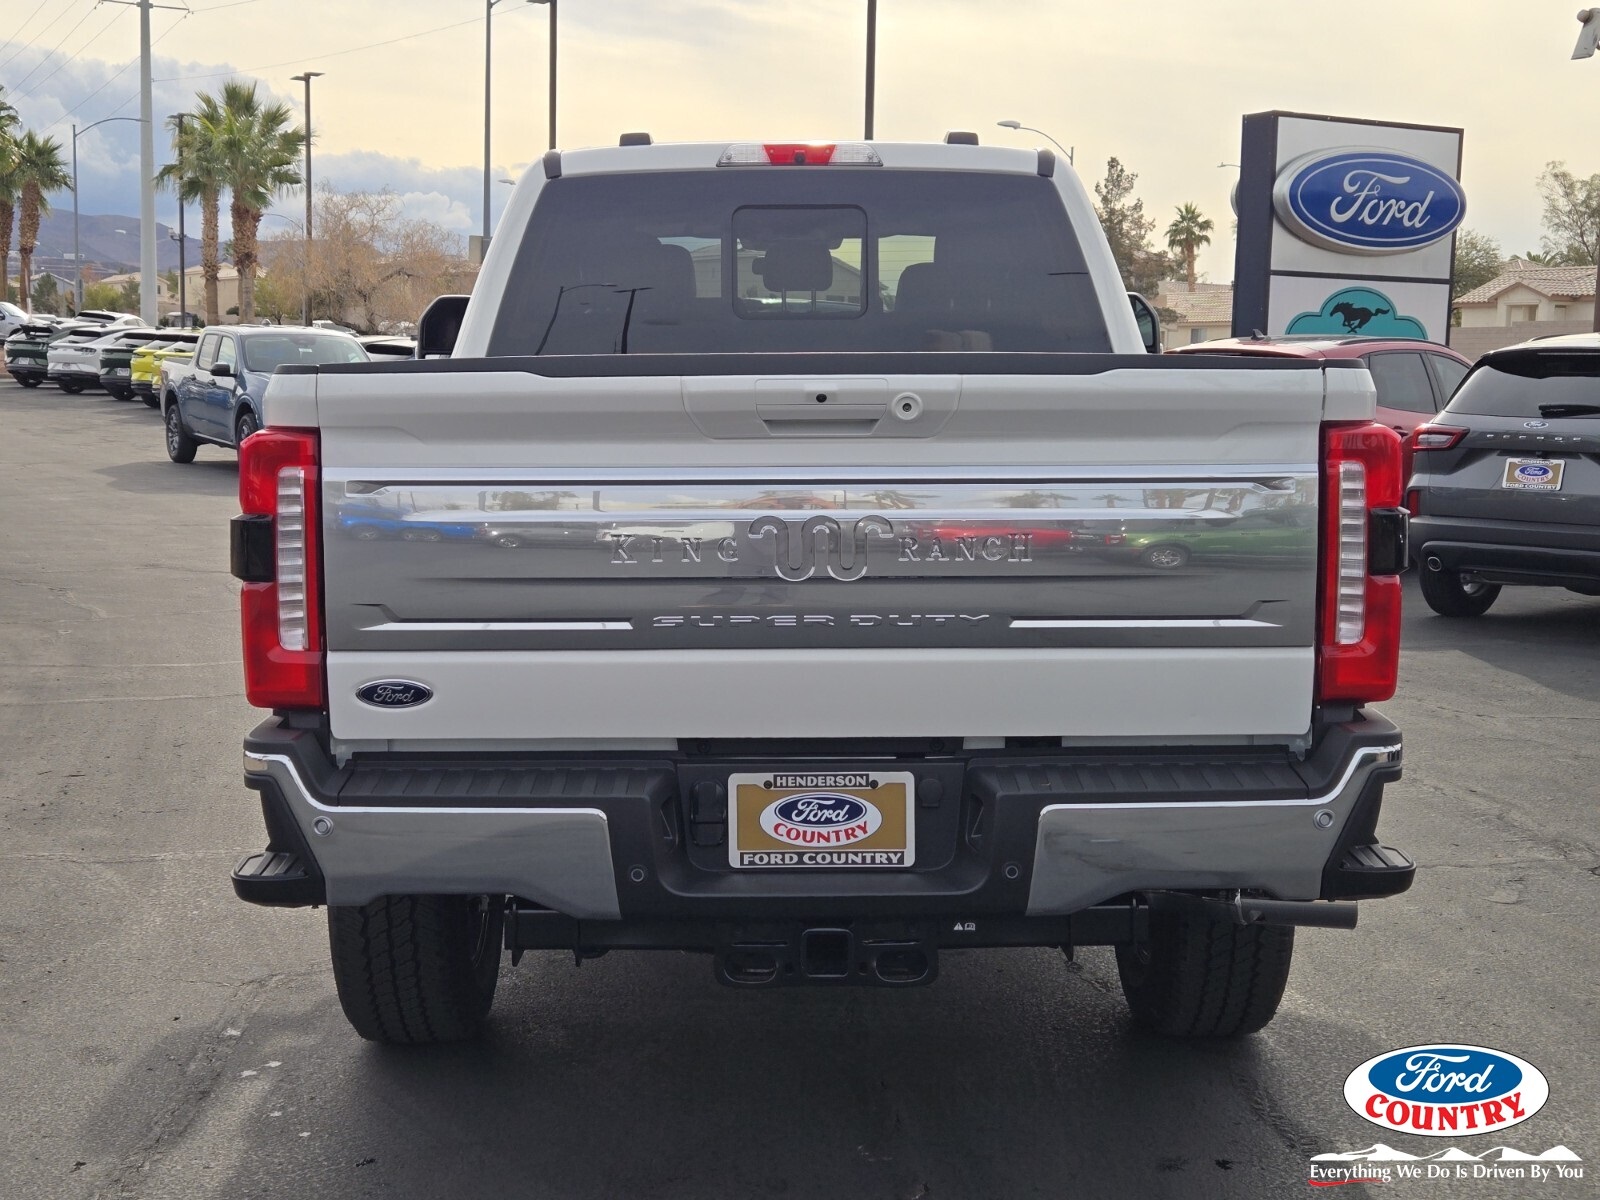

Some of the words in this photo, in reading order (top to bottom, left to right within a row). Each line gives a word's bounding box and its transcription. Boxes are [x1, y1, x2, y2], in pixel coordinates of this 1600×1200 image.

[1330, 169, 1435, 229] Ford
[1517, 474, 1550, 483] COUNTRY
[1524, 467, 1544, 476] Ford
[610, 534, 739, 564] KING
[898, 532, 1034, 563] RANCH
[652, 614, 836, 629] SUPER
[850, 614, 990, 628] DUTY
[373, 685, 415, 702] Ford
[776, 775, 867, 787] HENDERSON
[791, 799, 849, 822] Ford
[773, 821, 869, 843] COUNTRY
[743, 854, 799, 865] FORD
[802, 853, 902, 864] COUNTRY
